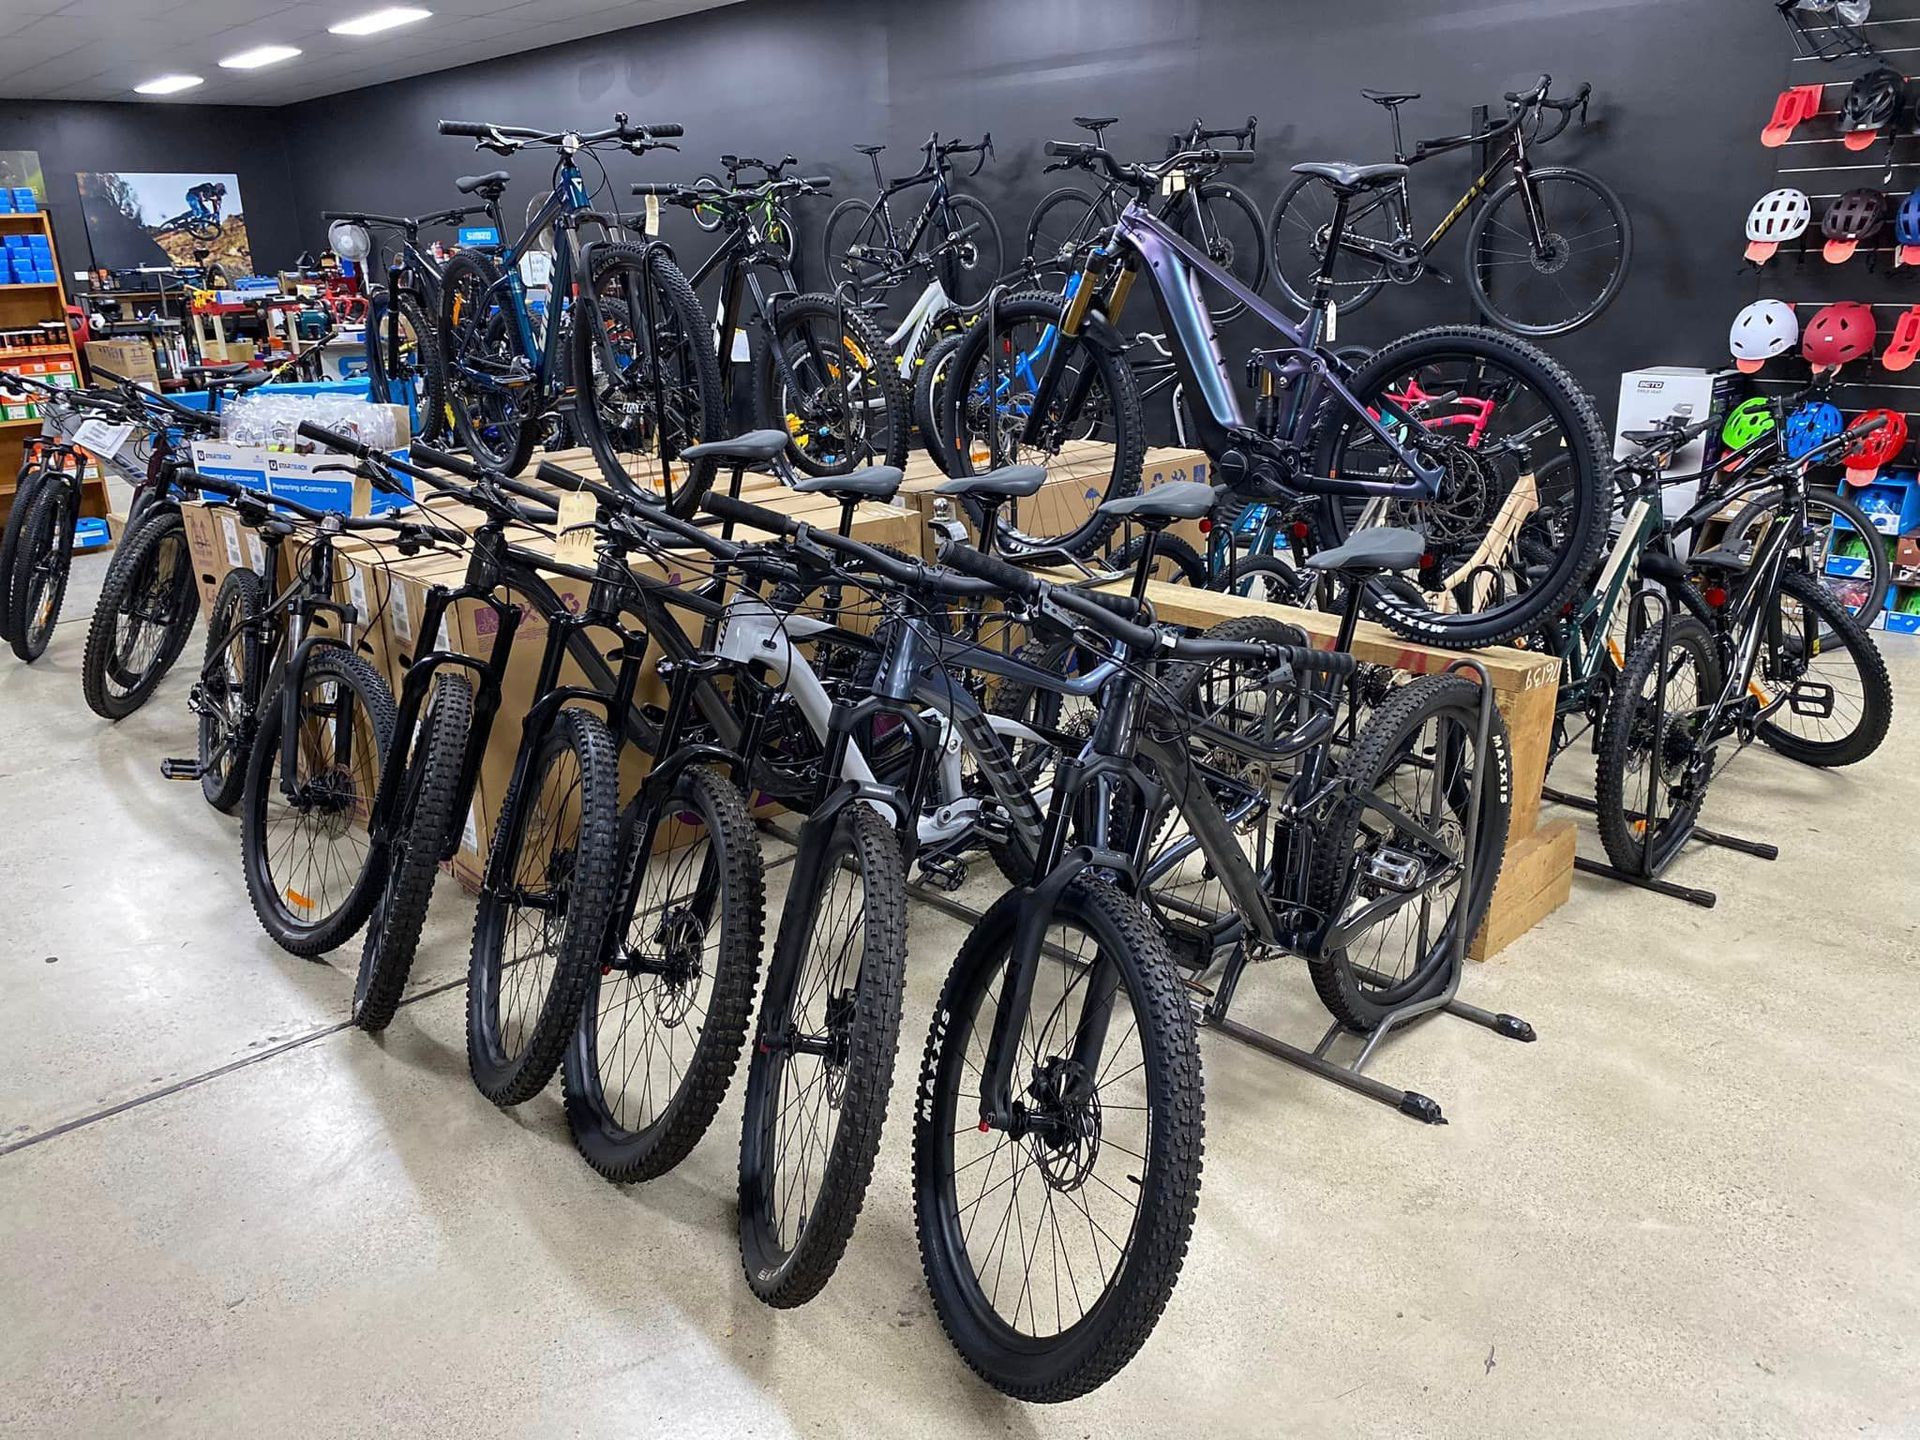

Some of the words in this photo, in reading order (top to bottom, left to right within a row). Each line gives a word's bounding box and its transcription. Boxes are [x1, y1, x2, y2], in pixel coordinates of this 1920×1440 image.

[1375, 601, 1448, 633] MAXXIS
[1492, 734, 1508, 804] MAXXIS
[922, 1008, 950, 1122] MAXXIS
